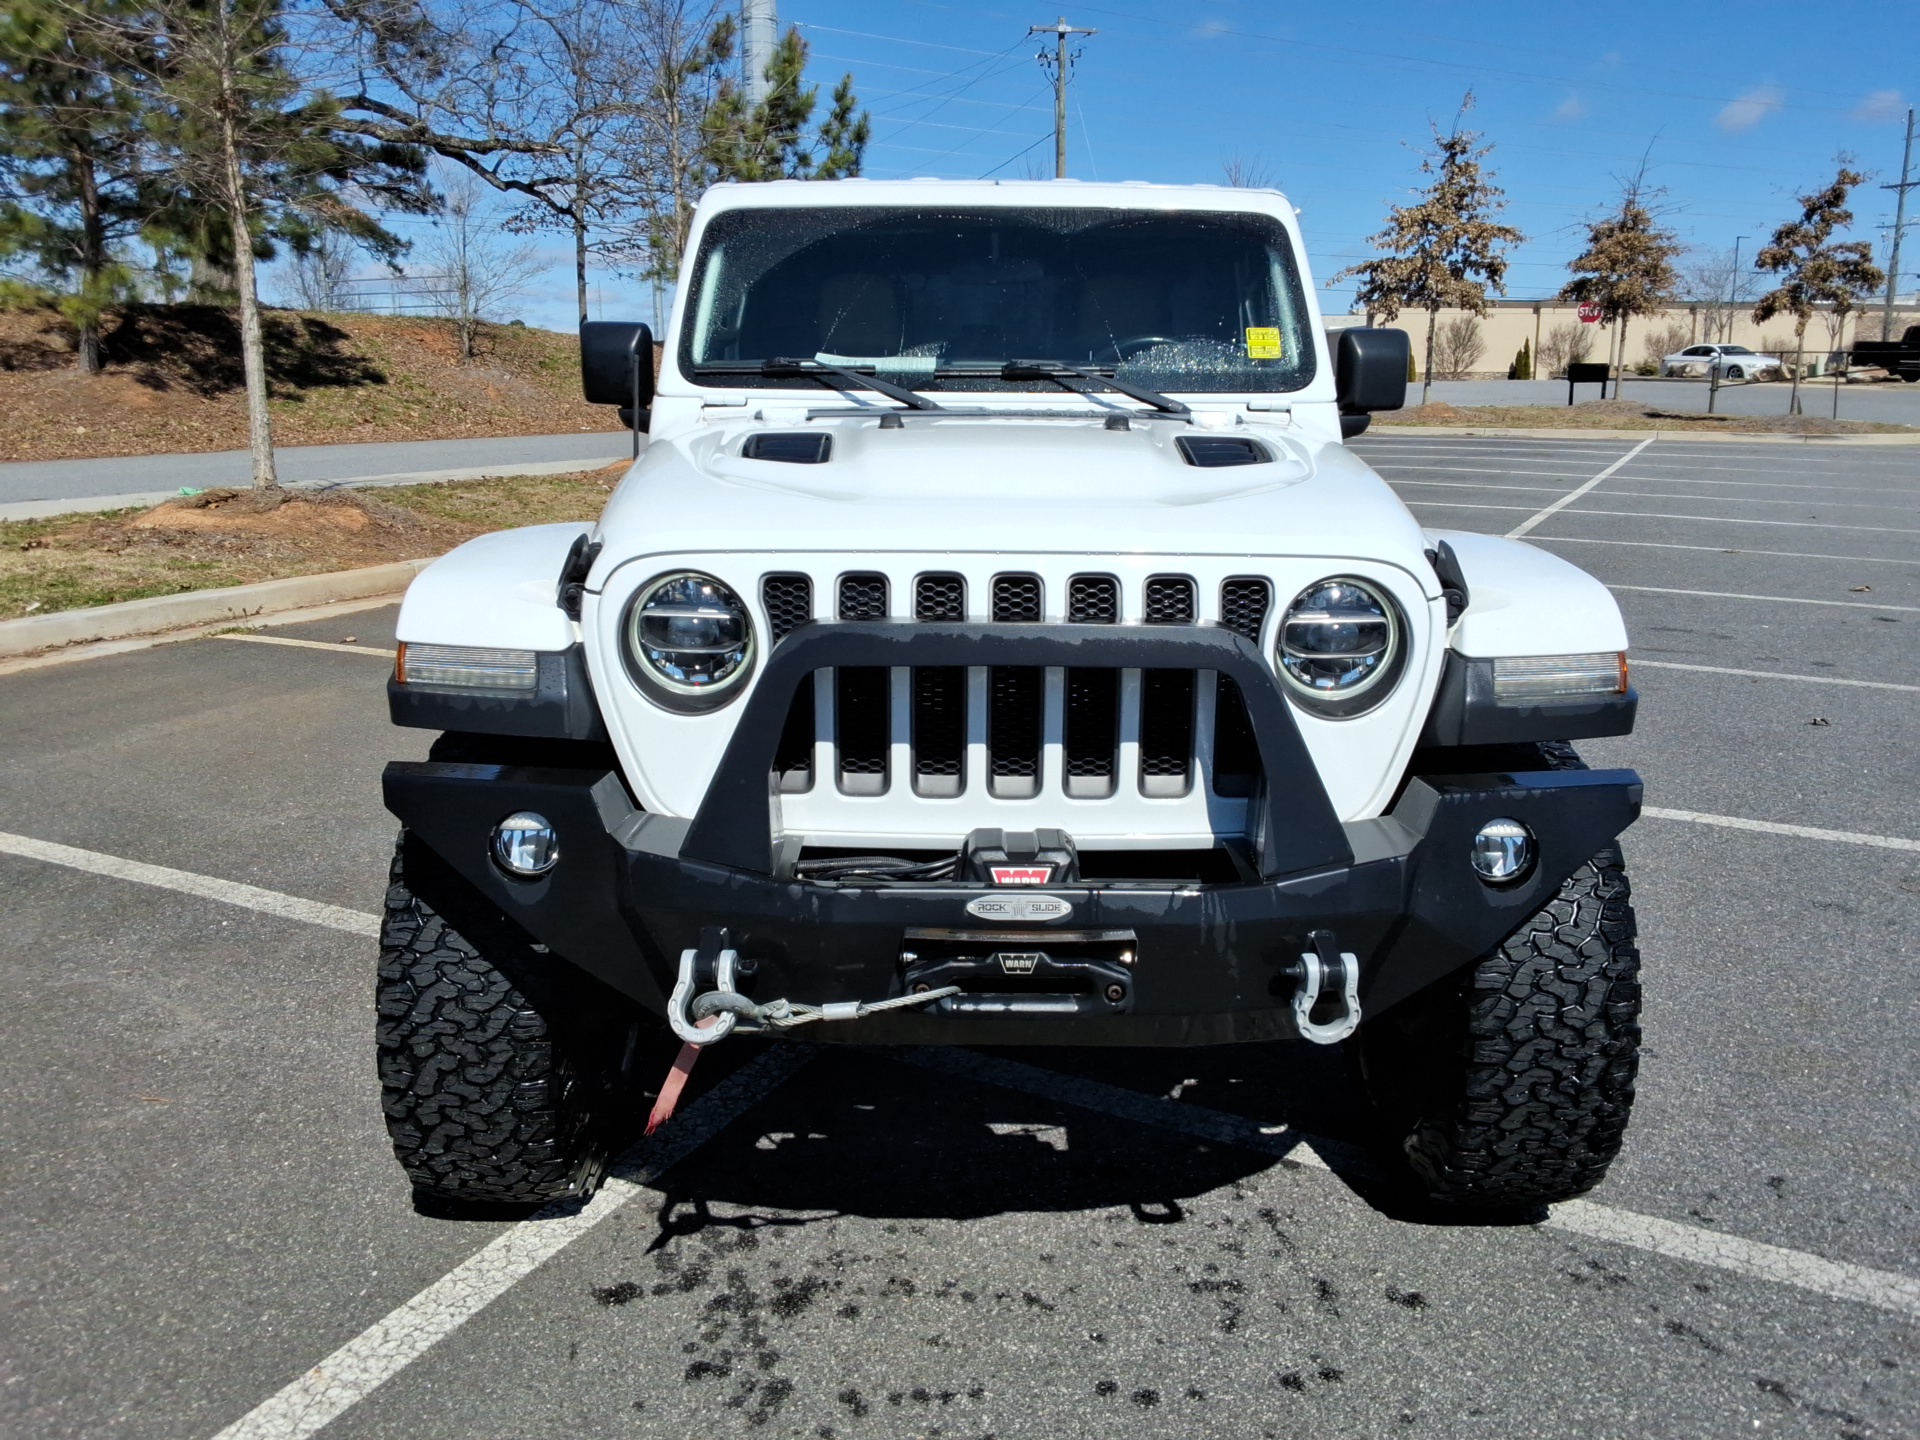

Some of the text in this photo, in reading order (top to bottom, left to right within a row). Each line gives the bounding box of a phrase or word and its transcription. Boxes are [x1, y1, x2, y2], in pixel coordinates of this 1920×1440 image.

[977, 903, 1061, 912] ROCK SLIDE
[1005, 959, 1032, 968] WARN
